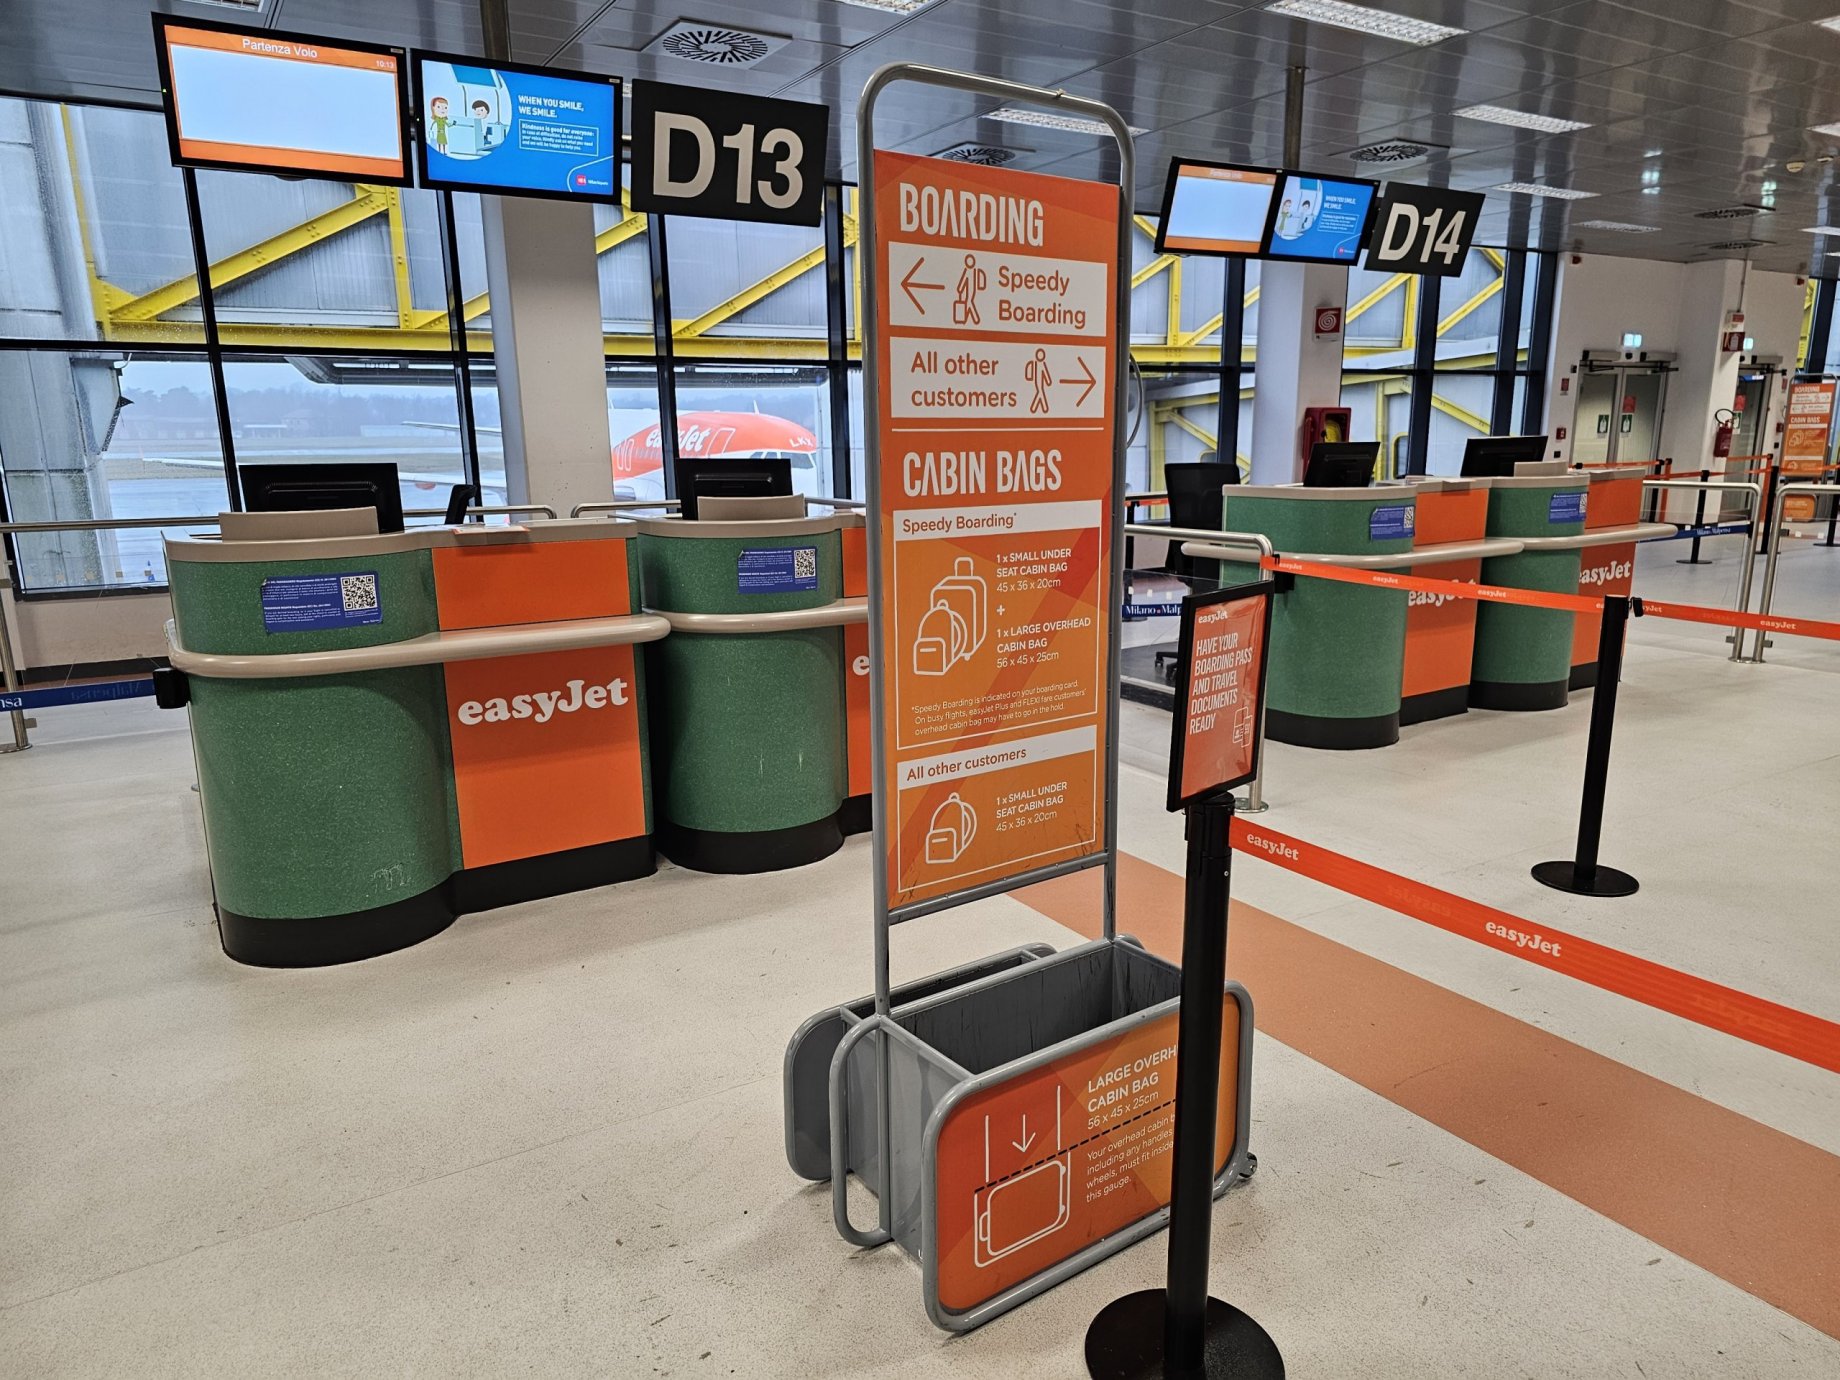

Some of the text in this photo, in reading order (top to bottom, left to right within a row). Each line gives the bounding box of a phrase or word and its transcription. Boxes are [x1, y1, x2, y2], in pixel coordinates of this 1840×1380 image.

[242, 38, 318, 58] Partenza Volo
[518, 95, 584, 112] WHEN YOU SMILE,
[518, 106, 558, 118] WE SMILE.
[653, 111, 804, 209] D13
[900, 182, 1044, 246] BOARDING
[1377, 202, 1467, 265] D14
[998, 265, 1070, 296] Speedy
[999, 299, 1087, 329] Boarding
[911, 351, 999, 376] All other
[911, 387, 1017, 408] customers
[788, 438, 814, 449] LKX
[903, 449, 1062, 497] CABIN BAGS
[902, 517, 952, 535] Speedy
[996, 554, 1000, 563] 1
[1009, 552, 1039, 562] SMALL
[1040, 548, 1072, 560] UNDER
[996, 562, 1068, 578] SEAT CABIN BAG
[1372, 576, 1398, 584] easyJet
[1579, 560, 1632, 586] asyJet
[996, 582, 1008, 592] 45
[1017, 580, 1028, 590] 36
[1037, 578, 1061, 589] 20cm
[1478, 589, 1506, 598] easyJet
[1126, 605, 1156, 615] Milano
[1198, 609, 1229, 624] easyJet
[996, 629, 1000, 638] 1
[1010, 624, 1041, 637] LARGE
[1042, 617, 1091, 632] OVERHEAD
[1760, 620, 1796, 630] easyJet
[996, 638, 1048, 654] CABIN BAG
[1196, 632, 1239, 656] HAVE YOUR
[996, 658, 1008, 668] 56
[1016, 655, 1028, 665] 45
[1037, 651, 1060, 662] 25cm
[1194, 647, 1253, 676] BOARDING PASS
[1192, 670, 1238, 697] AND TRAVEL
[457, 677, 629, 726] easyJet
[942, 698, 973, 710] Boarding
[974, 696, 980, 704] is
[982, 691, 1011, 702] indicated
[1022, 688, 1036, 697] your
[1036, 684, 1064, 694] boarding
[1190, 688, 1238, 716] DOCUMENTS
[914, 716, 926, 724] On
[927, 714, 944, 723] busy
[945, 710, 968, 720] flights,
[969, 706, 994, 715] easyJet
[995, 702, 1009, 710] Plus
[1010, 701, 1022, 709] and
[1022, 697, 1040, 706] FLEXI
[914, 722, 948, 736] overhead
[949, 721, 968, 730] cabin
[969, 718, 982, 726] bag
[983, 716, 998, 724] may
[998, 712, 1014, 720] have
[1015, 710, 1022, 718] to
[1190, 713, 1216, 735] READY
[906, 750, 1027, 781] All other customers
[996, 797, 1000, 806] 1
[1008, 790, 1037, 804] SMALL
[1038, 782, 1068, 796] UNDER
[996, 795, 1064, 819] SEAT CABIN BAG
[996, 822, 1007, 832] 45
[1009, 822, 1014, 830] x
[1016, 817, 1026, 827] 36
[1034, 811, 1058, 823] 20cm
[1246, 834, 1299, 860] easyJet
[1485, 922, 1562, 957] easyJet
[1088, 1044, 1178, 1094] LARGE OVERH
[1088, 1072, 1159, 1112] CABIN BAG
[1087, 1092, 1159, 1130] 56 x 45 x 25cm
[1087, 1147, 1107, 1161] Your
[1108, 1126, 1146, 1152] overhead
[1147, 1117, 1169, 1134] cabin
[1086, 1141, 1174, 1189] wheels, must fit inside
[1087, 1129, 1173, 1176] including any handles
[1086, 1175, 1132, 1203] this gauge.
